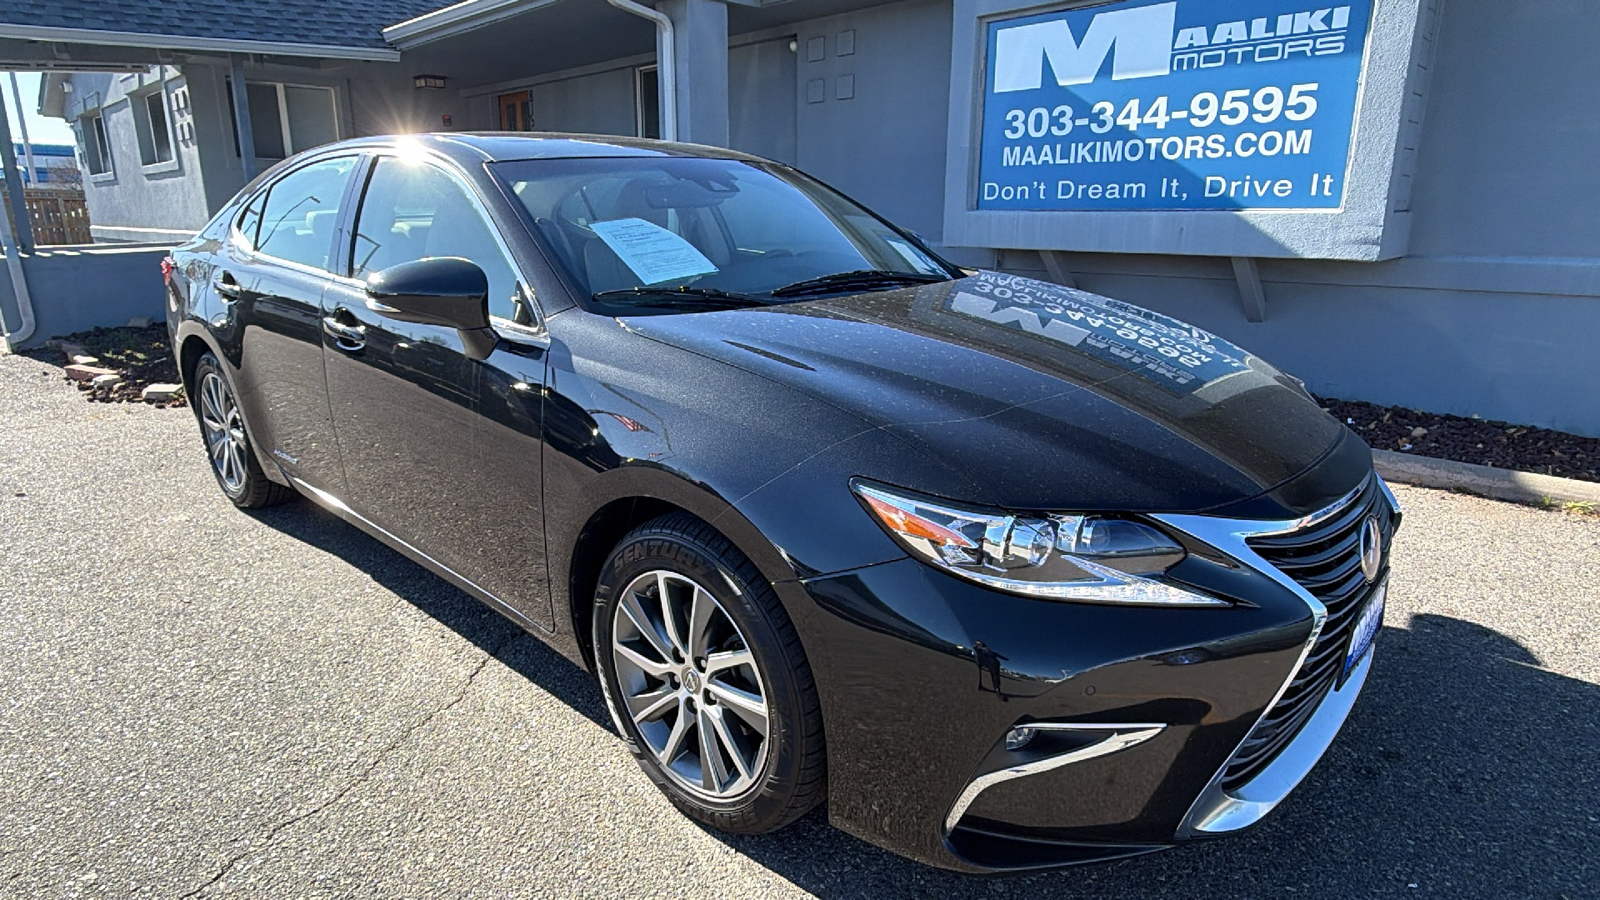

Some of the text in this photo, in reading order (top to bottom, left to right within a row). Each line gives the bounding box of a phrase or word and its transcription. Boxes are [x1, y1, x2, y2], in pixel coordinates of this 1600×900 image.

[1173, 35, 1346, 71] MOTORS
[1004, 83, 1318, 139] 303-344-9595
[1002, 129, 1312, 166] MAALIKIMOTORS.COM
[984, 173, 1334, 200] Don't Dream It, Drive It
